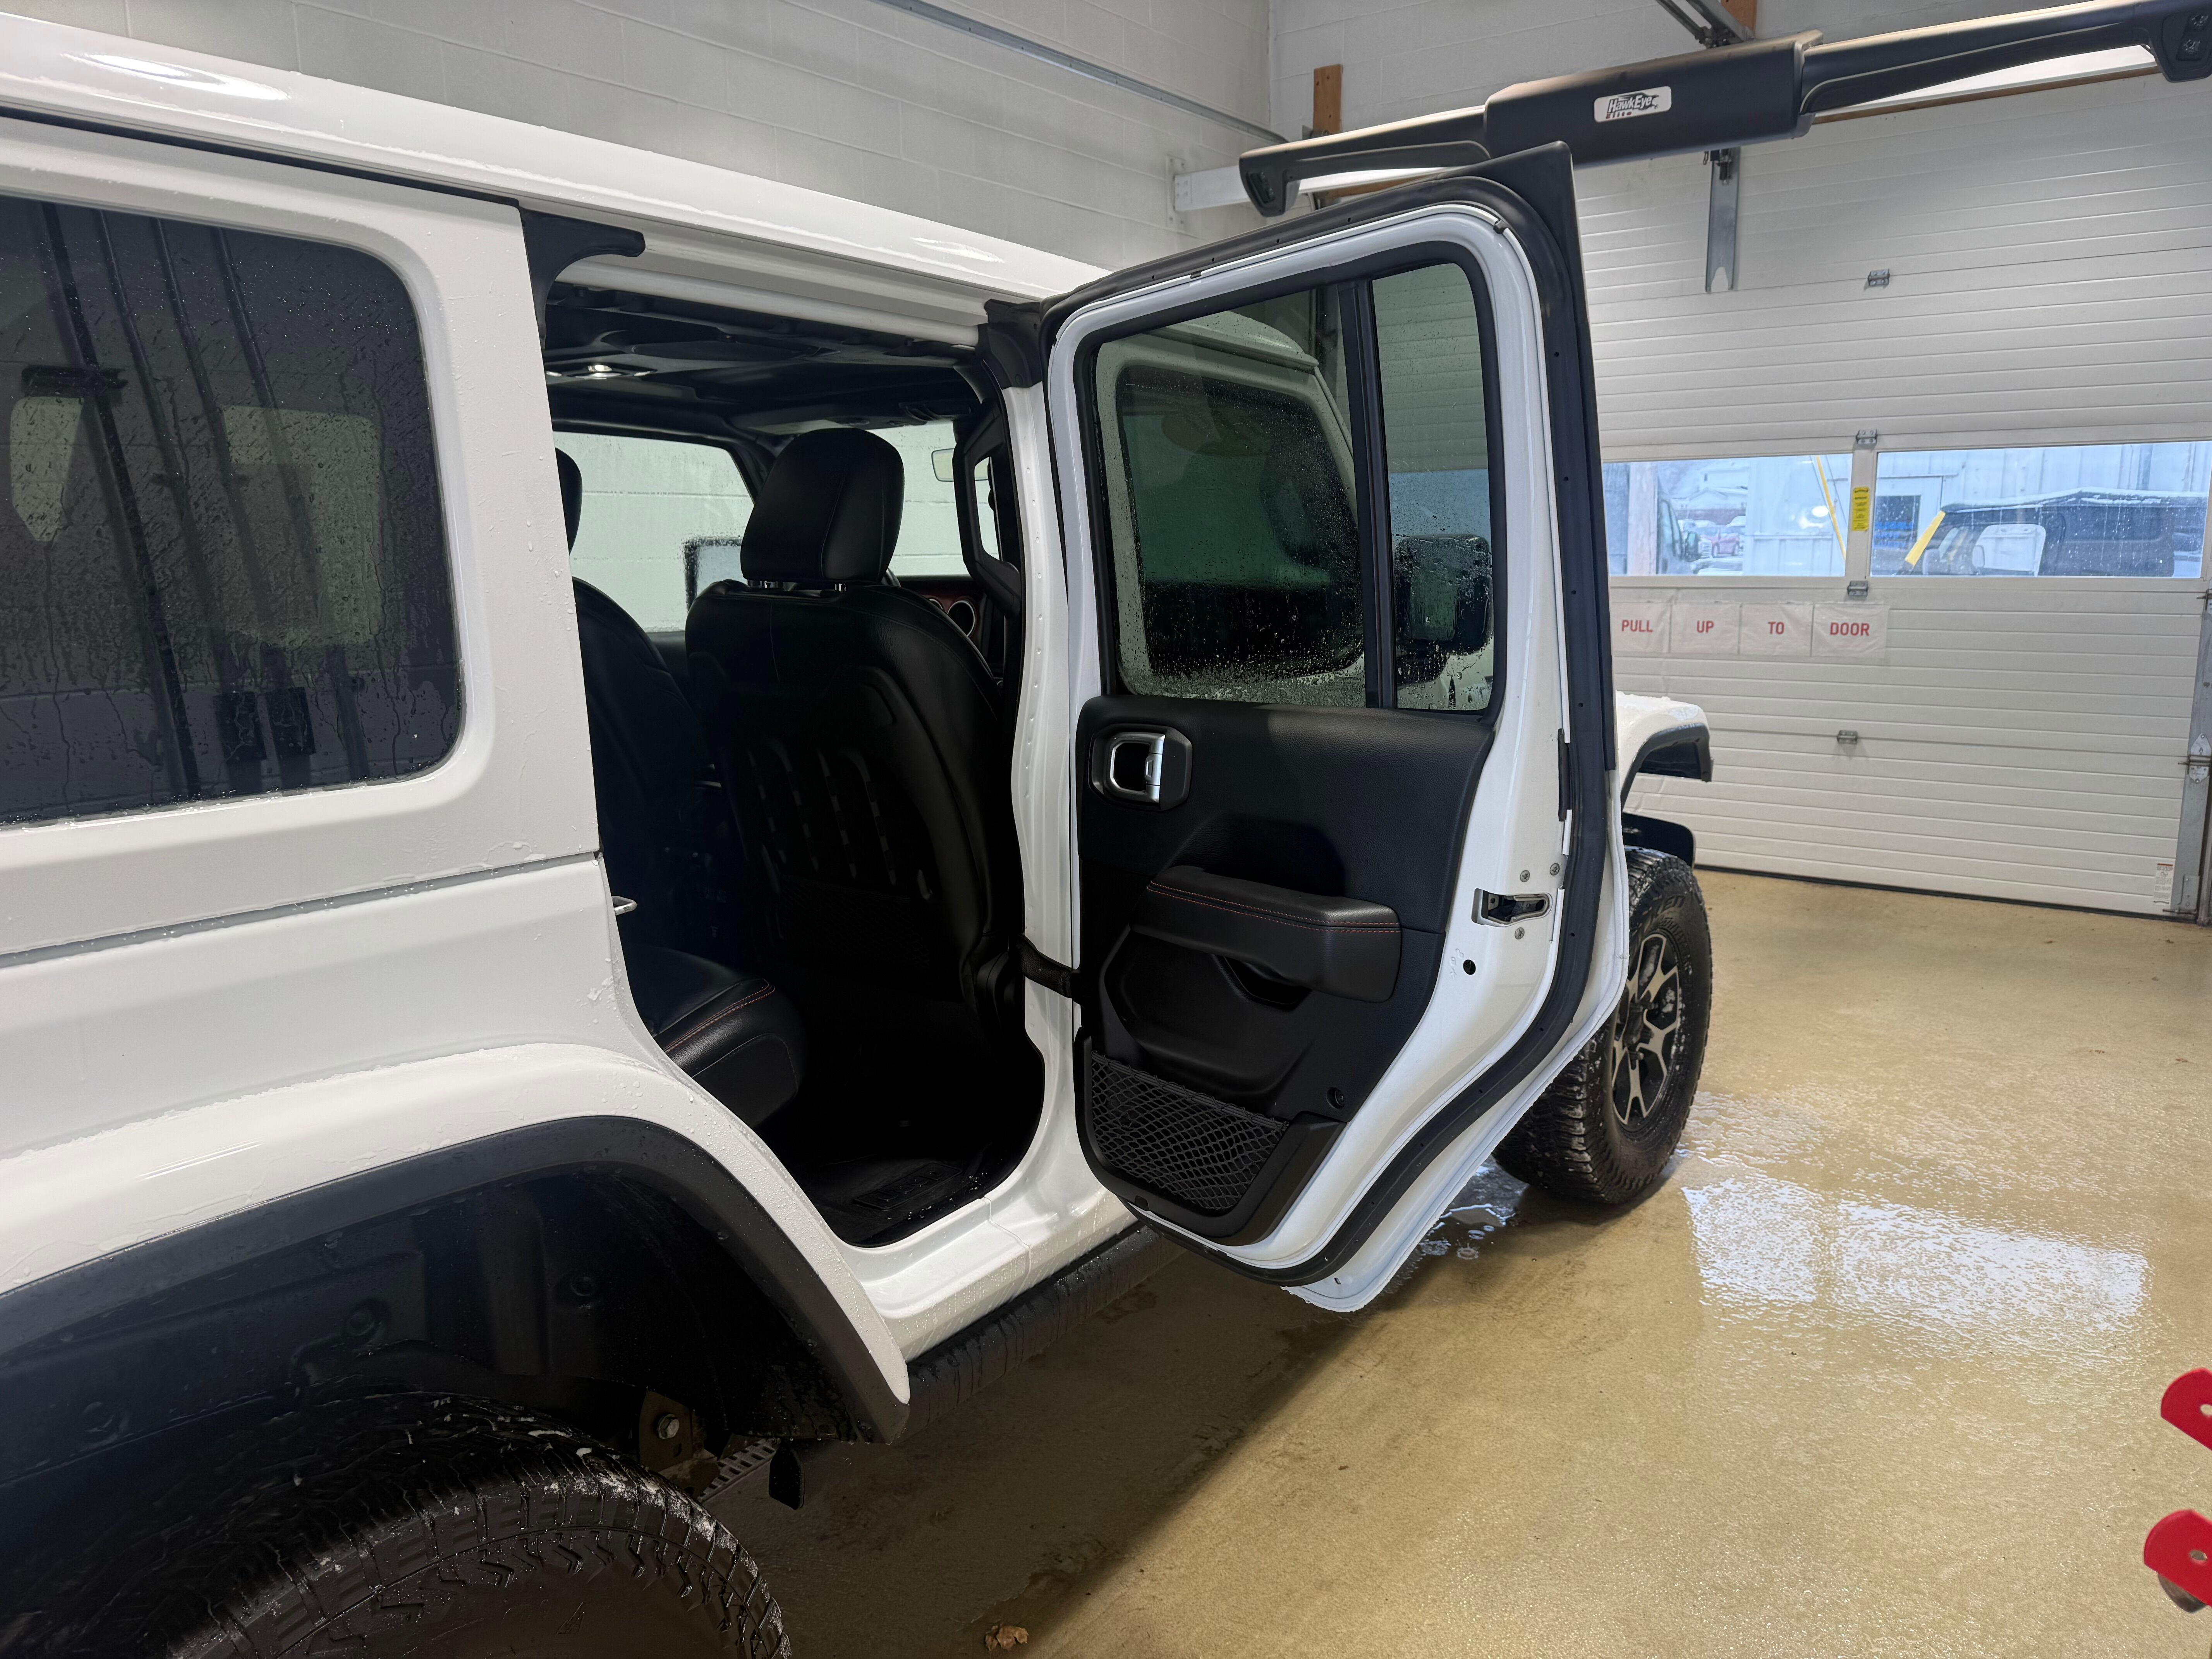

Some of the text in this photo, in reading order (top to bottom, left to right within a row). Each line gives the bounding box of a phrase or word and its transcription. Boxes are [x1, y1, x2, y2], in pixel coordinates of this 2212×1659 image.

[1607, 94, 1653, 113] HawkEye
[1621, 620, 1870, 636] PULL UP TO DOOR
